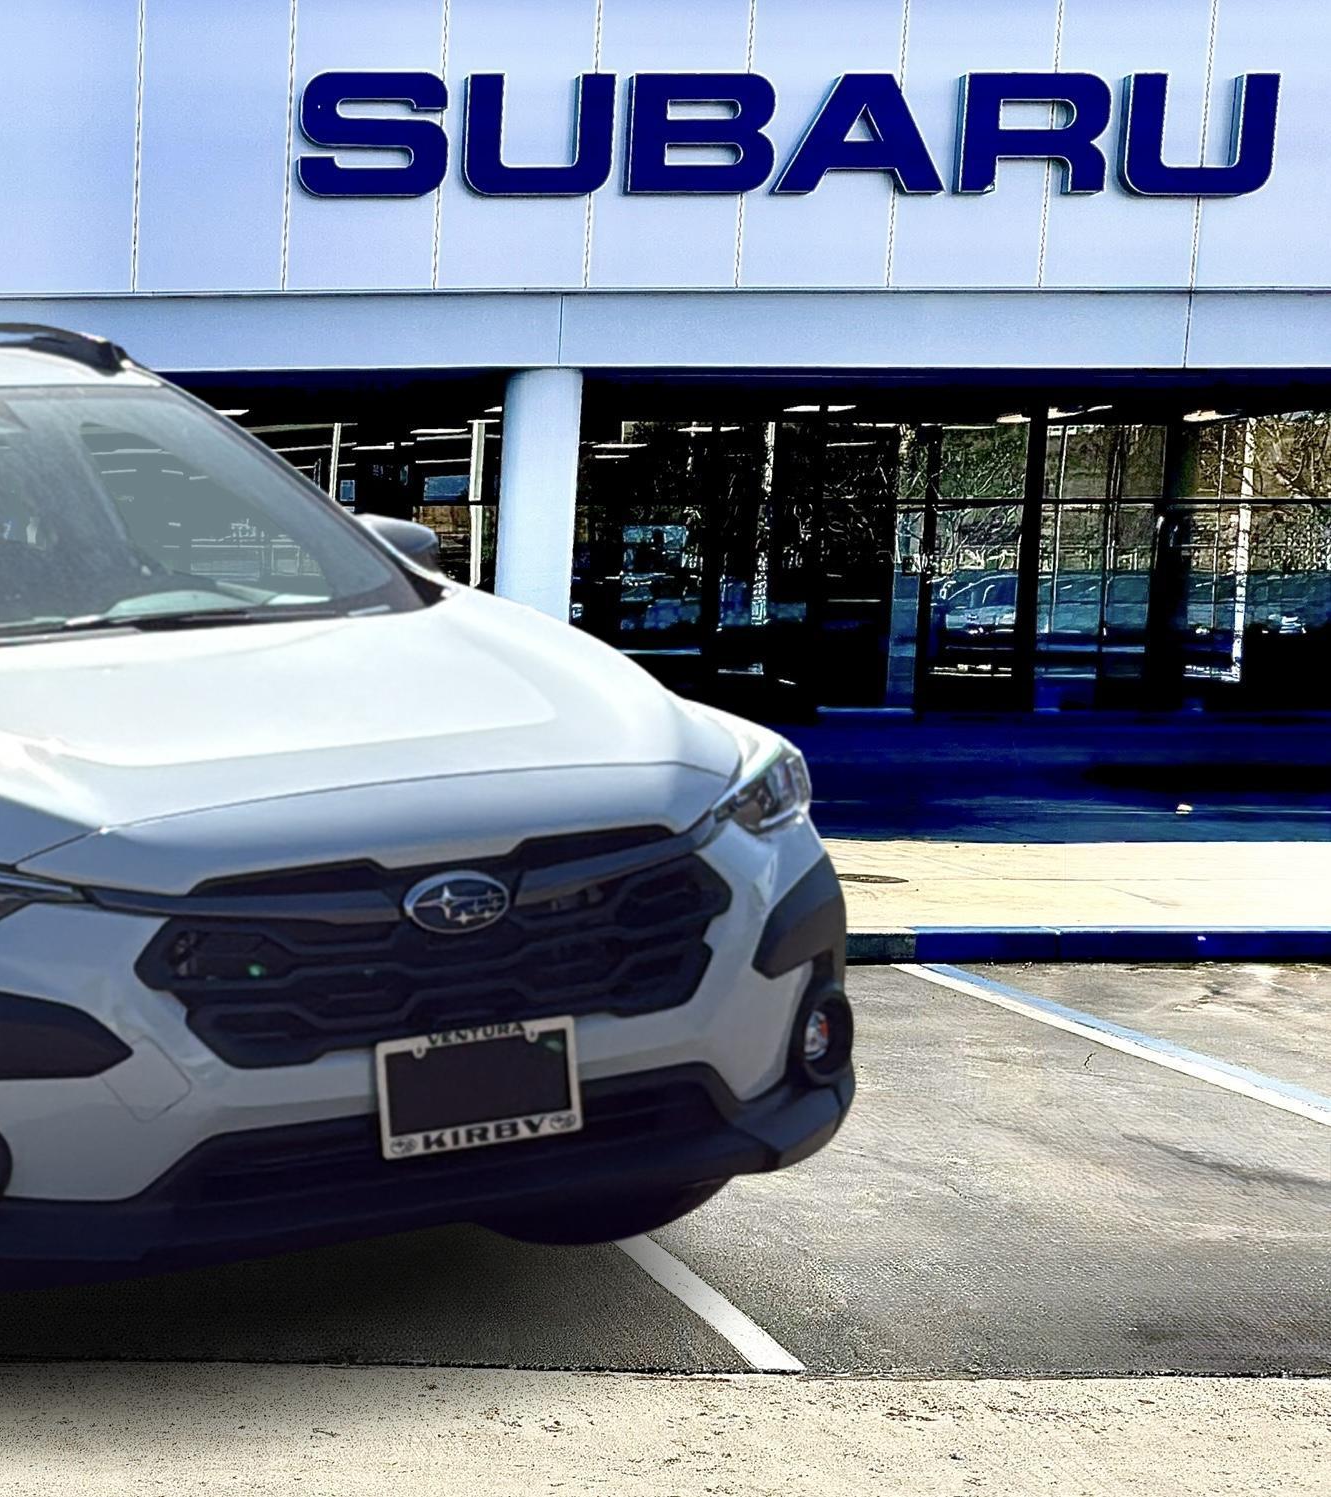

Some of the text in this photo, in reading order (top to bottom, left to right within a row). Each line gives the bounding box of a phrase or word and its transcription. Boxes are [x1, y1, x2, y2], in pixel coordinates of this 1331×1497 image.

[296, 71, 1280, 198] SUBARU
[427, 1022, 526, 1046] VENTURA
[423, 1115, 546, 1151] KIRBY
